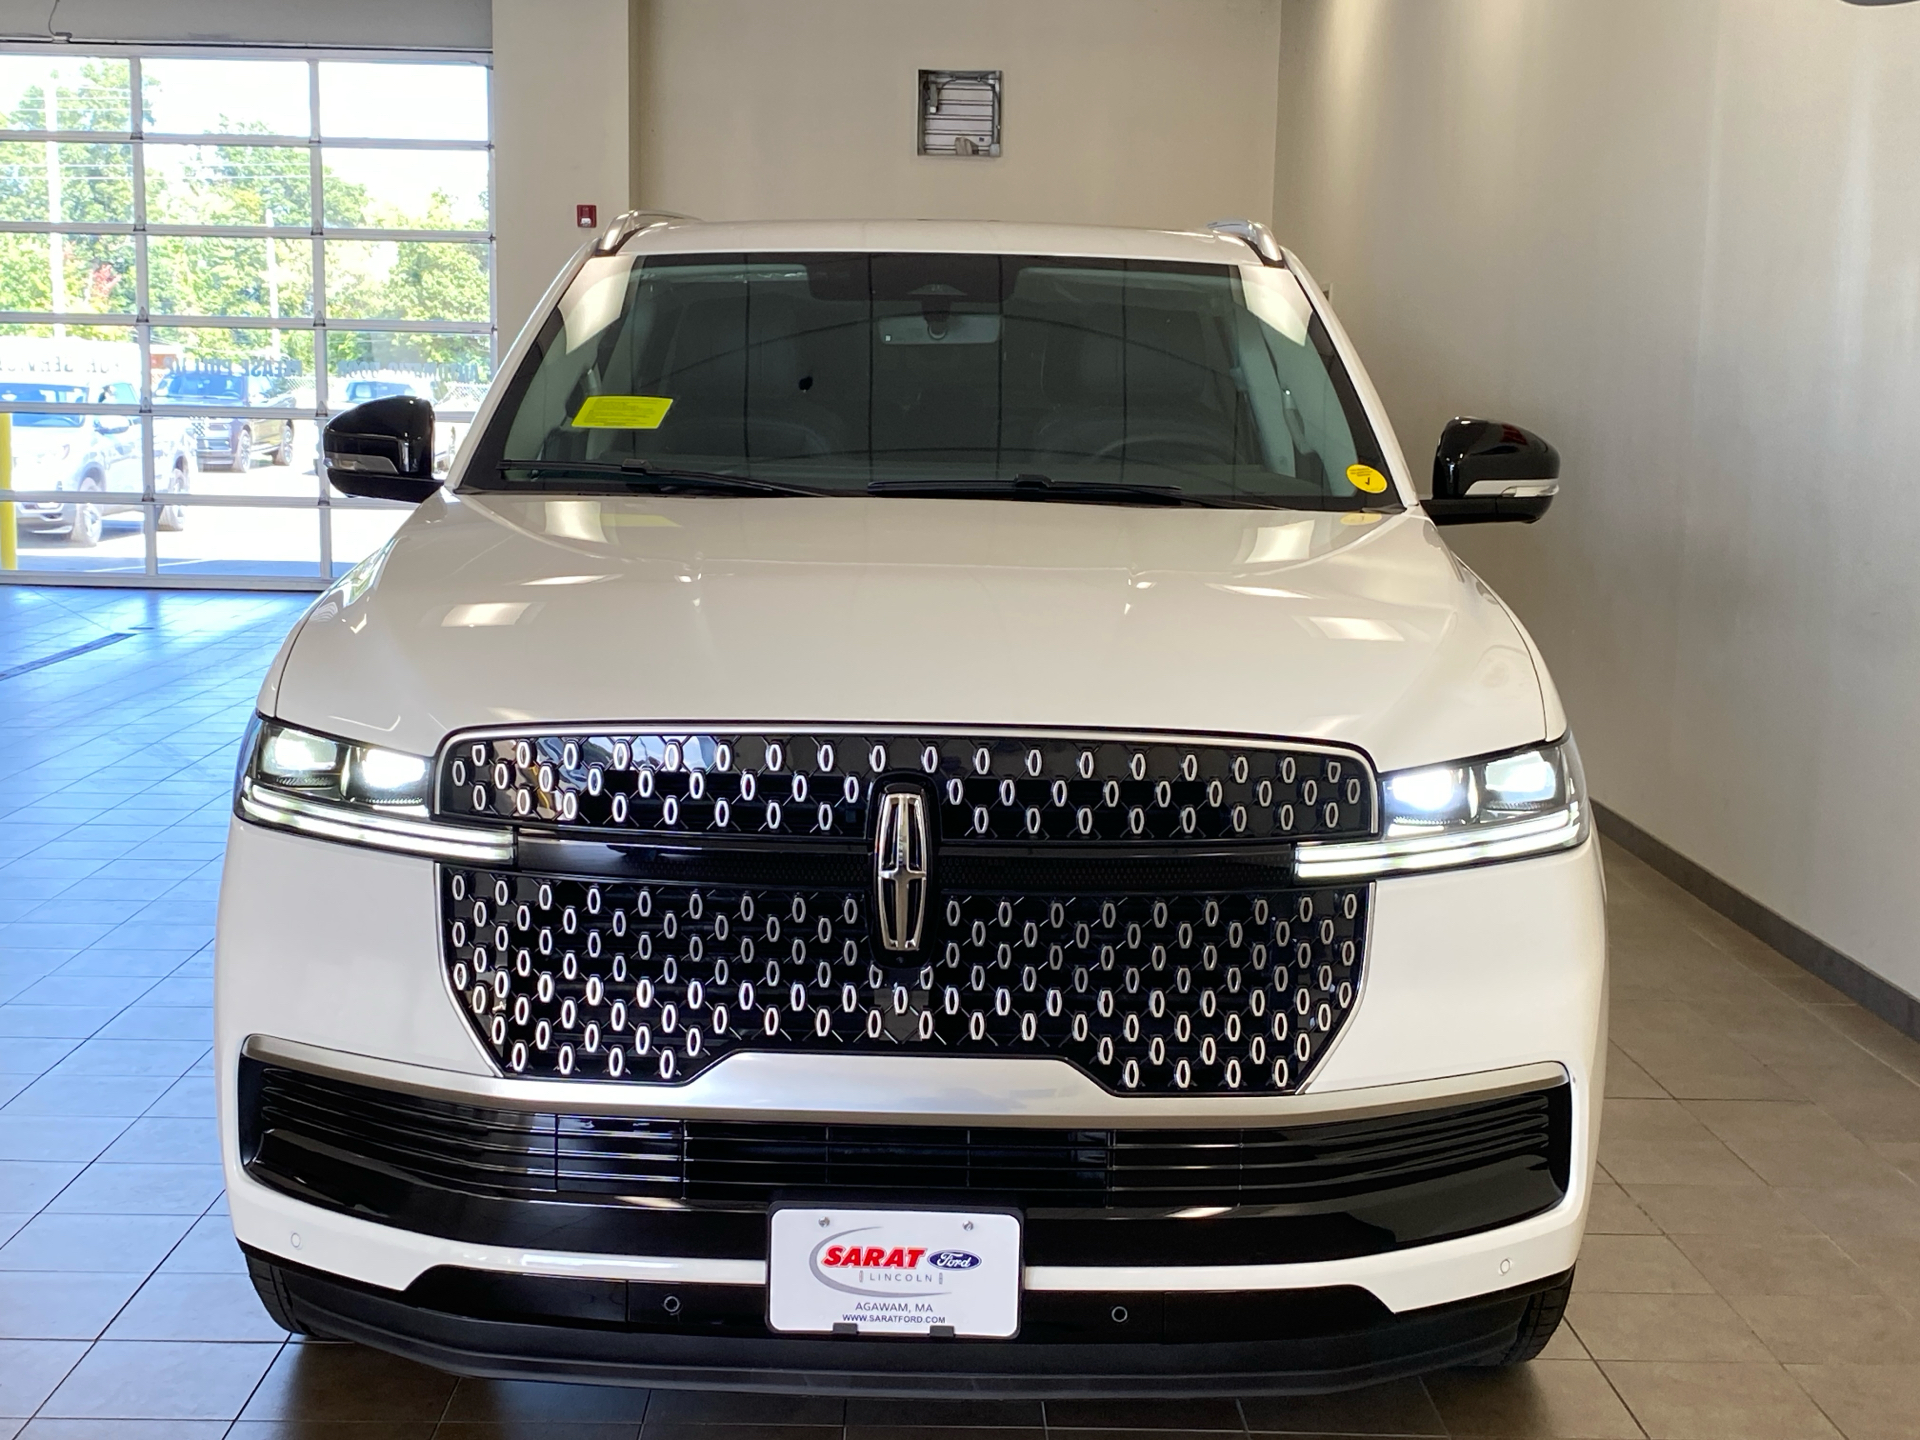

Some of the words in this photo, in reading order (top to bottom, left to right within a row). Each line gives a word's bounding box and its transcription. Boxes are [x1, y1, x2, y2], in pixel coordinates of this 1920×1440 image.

[821, 1245, 928, 1270] SARAT
[936, 1252, 972, 1268] Ford
[869, 1273, 933, 1283] LINCOLN
[855, 1302, 911, 1313] AGAWAM,
[915, 1303, 934, 1313] MA
[842, 1314, 946, 1324] WWW.SARATFORD.COM
